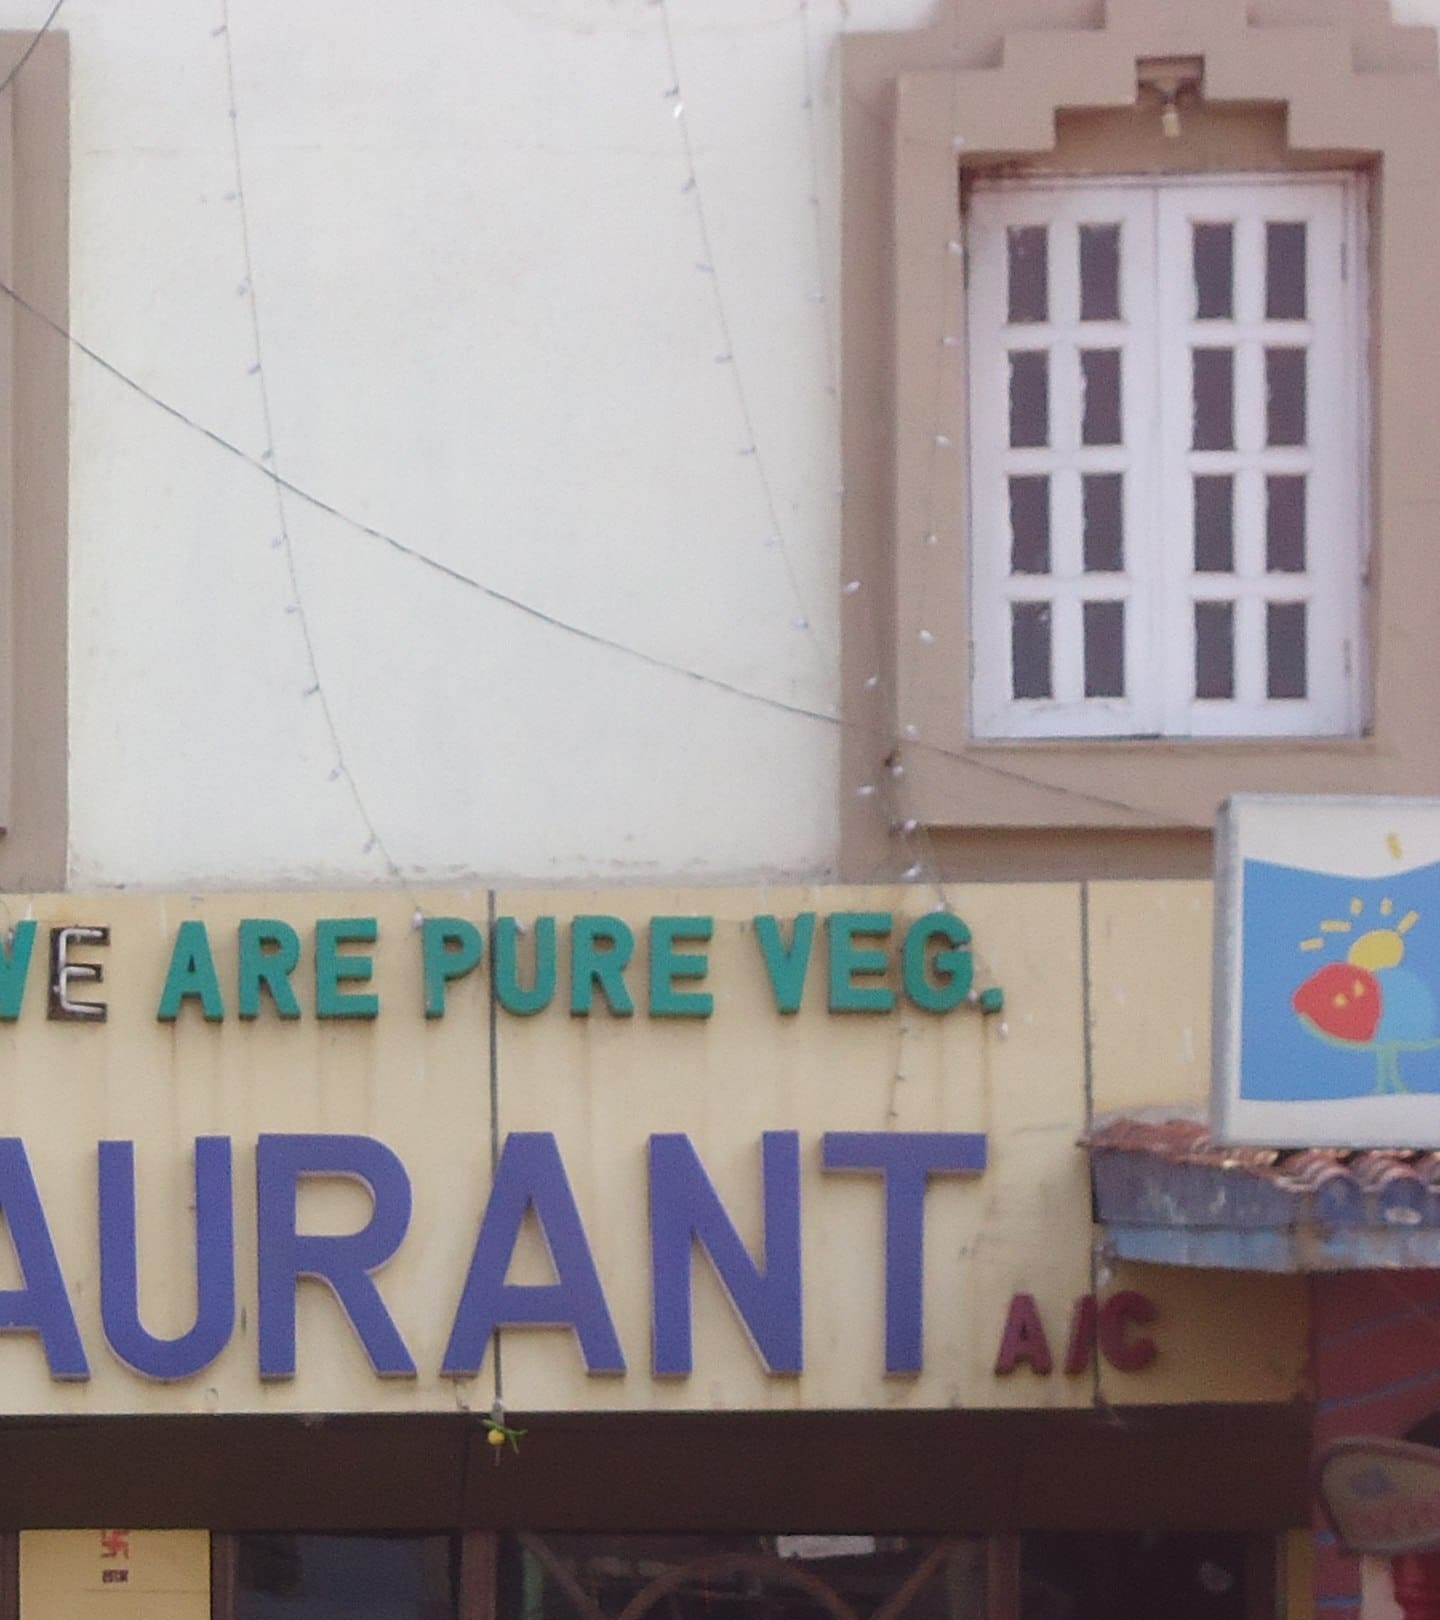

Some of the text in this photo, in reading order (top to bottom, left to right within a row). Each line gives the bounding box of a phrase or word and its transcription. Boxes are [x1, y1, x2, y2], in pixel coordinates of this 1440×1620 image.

[156, 917, 379, 1023] ARE
[423, 914, 714, 1020] PURE
[753, 910, 1004, 1016] VEG.
[993, 1289, 1162, 1378] A/C
